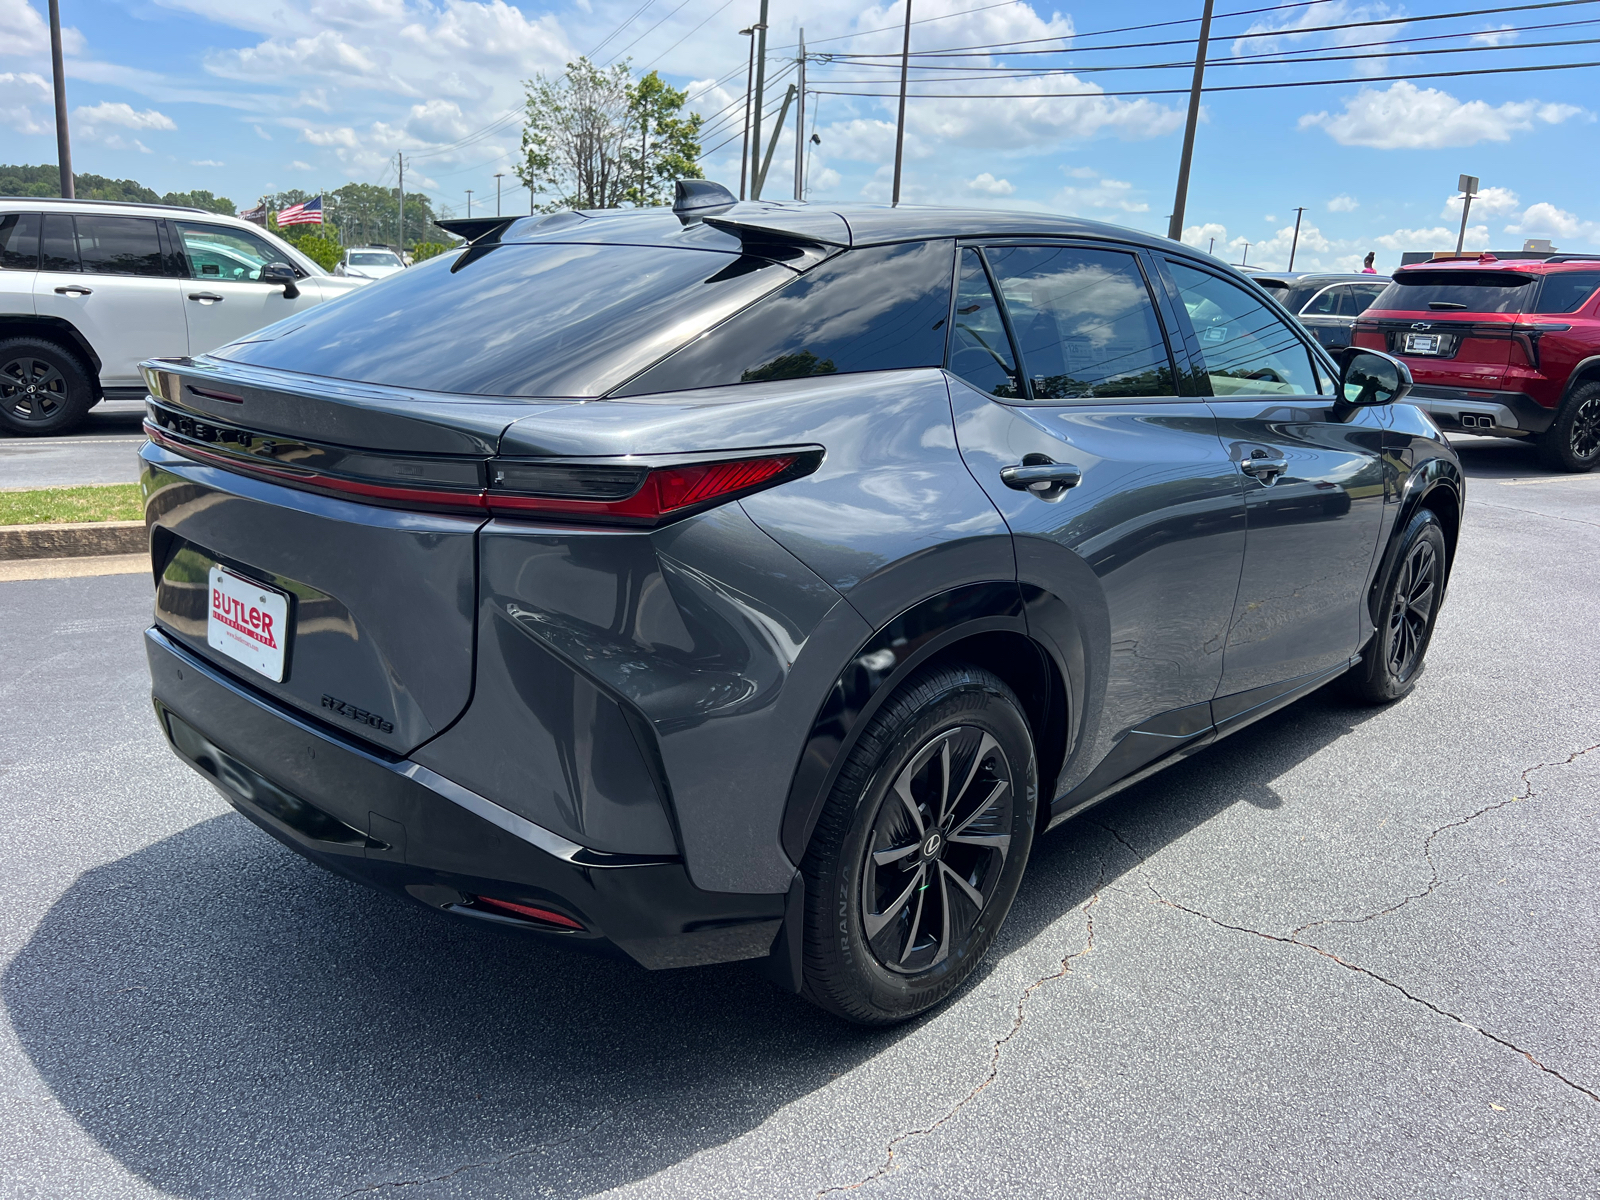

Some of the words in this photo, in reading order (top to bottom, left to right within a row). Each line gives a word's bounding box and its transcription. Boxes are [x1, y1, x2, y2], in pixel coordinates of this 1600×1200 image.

[179, 417, 275, 454] LEXUS
[213, 611, 249, 635] AUTOMOTIVE
[253, 630, 275, 648] GROUP
